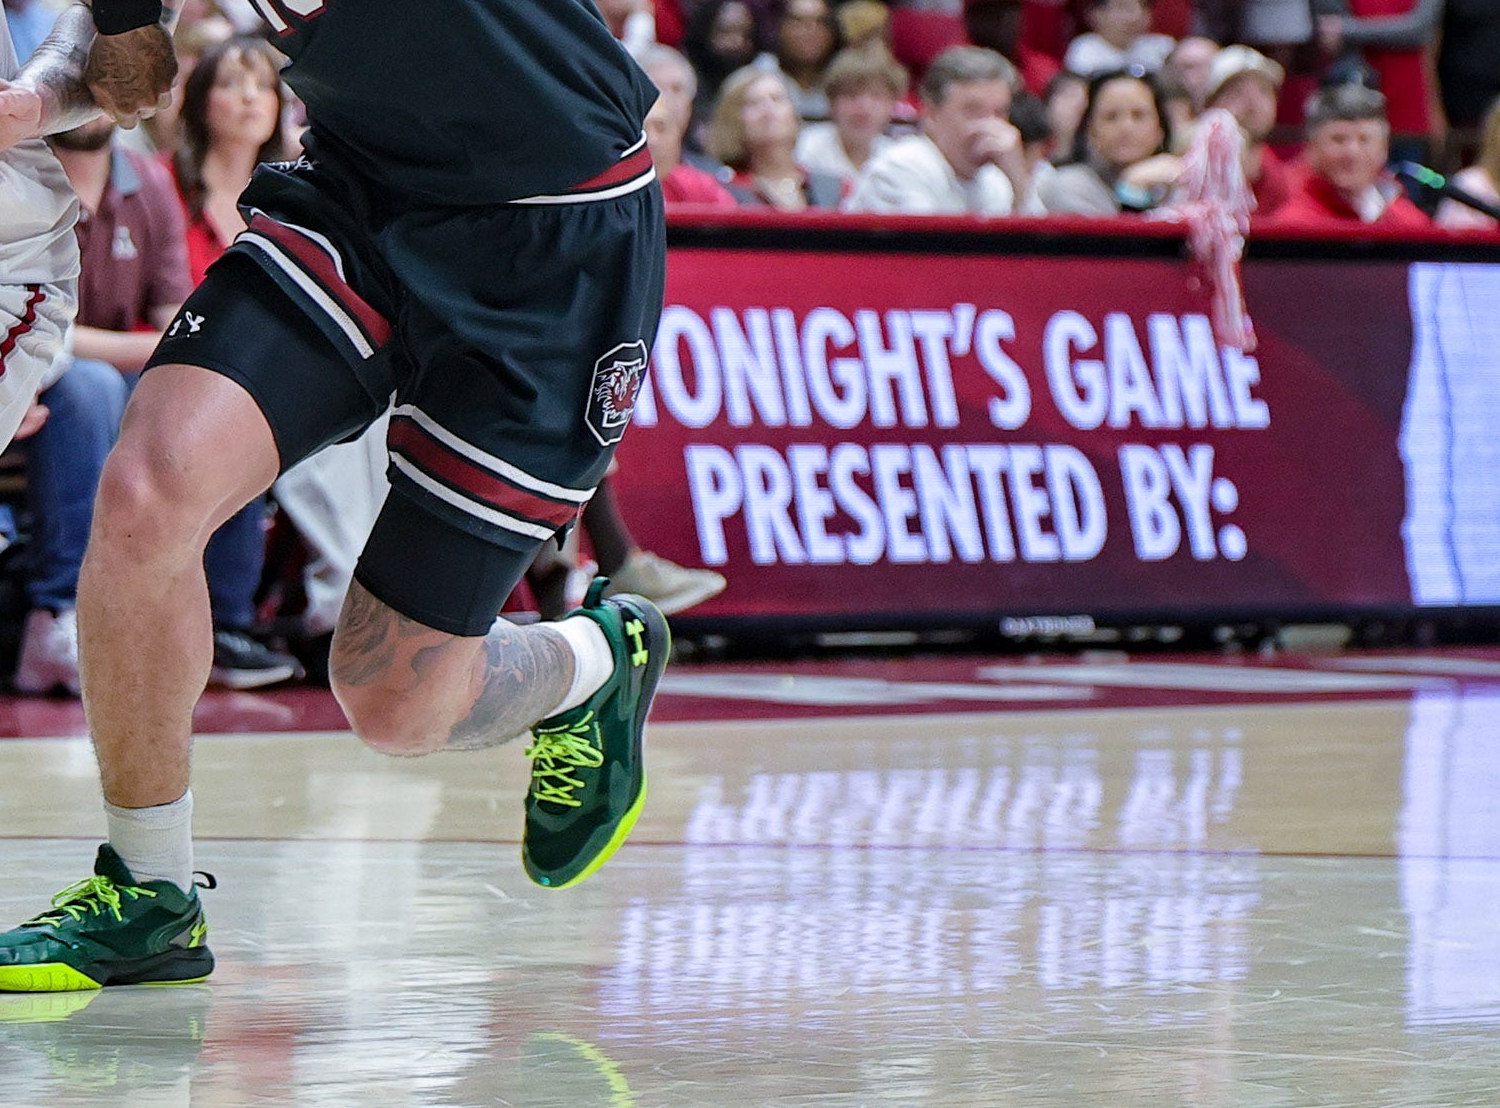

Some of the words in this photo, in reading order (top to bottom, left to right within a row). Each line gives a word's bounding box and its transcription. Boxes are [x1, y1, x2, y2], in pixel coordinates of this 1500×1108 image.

[1042, 308, 1271, 431] GAME
[683, 442, 1108, 566] PRESENTED
[1117, 443, 1248, 562] BY:
